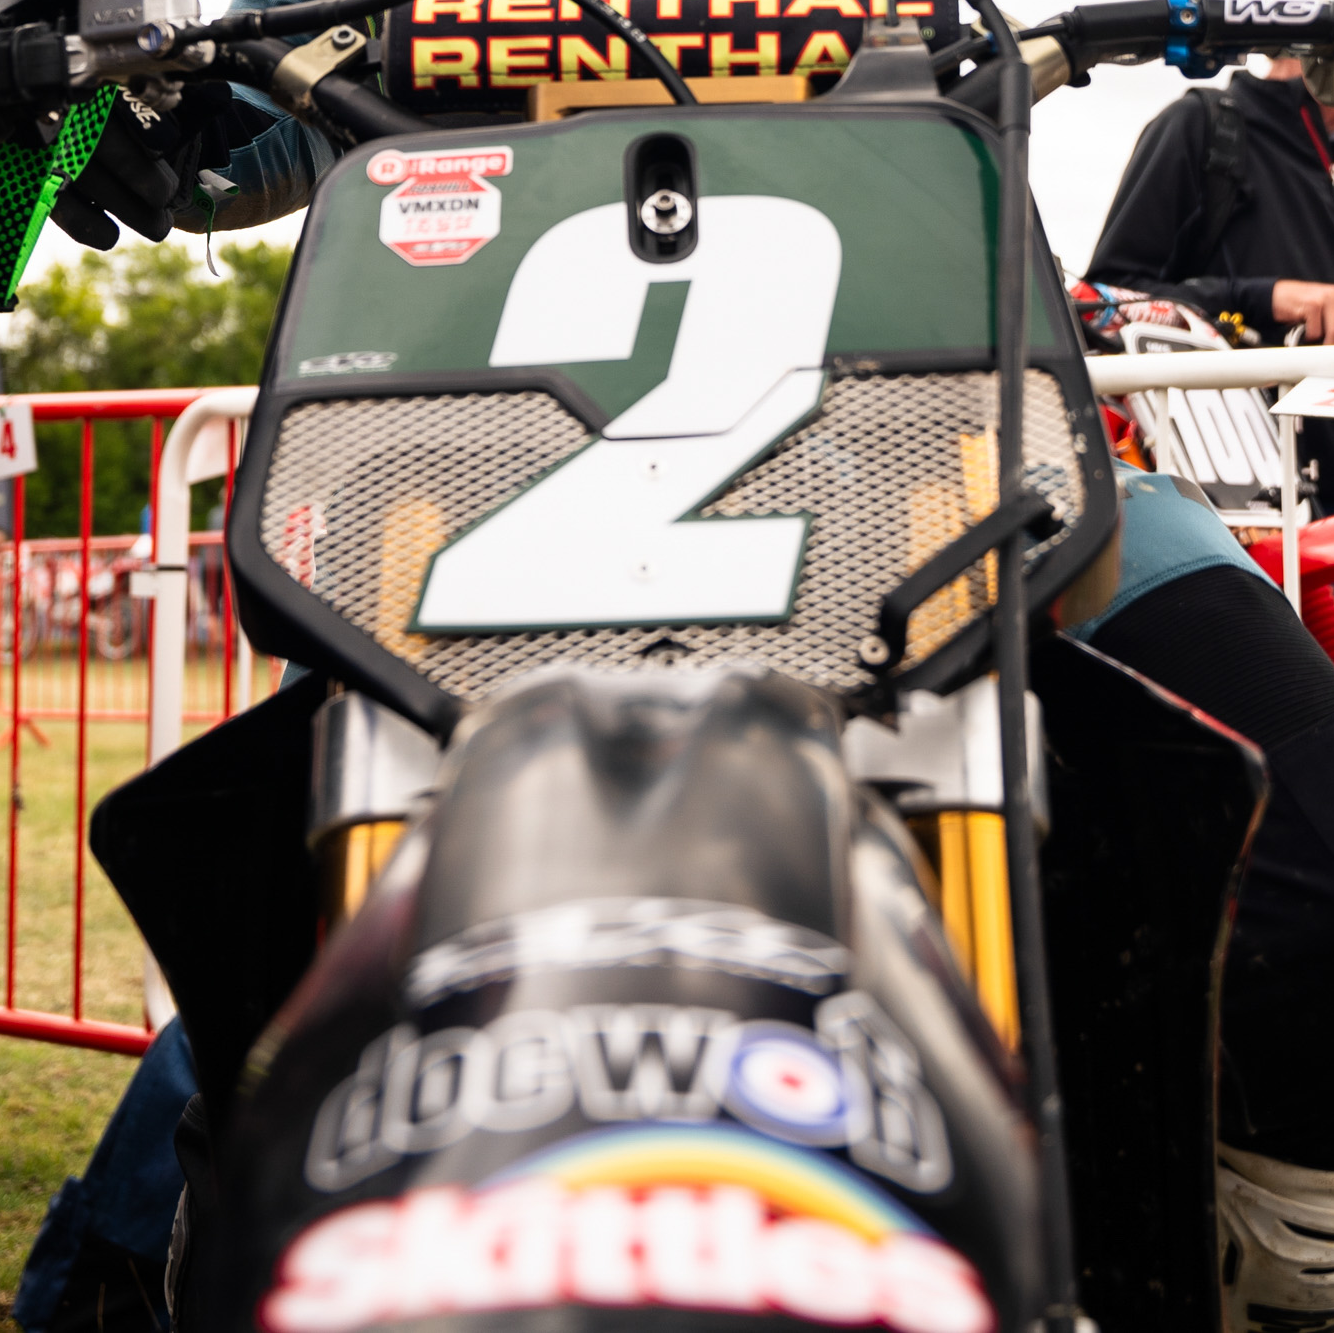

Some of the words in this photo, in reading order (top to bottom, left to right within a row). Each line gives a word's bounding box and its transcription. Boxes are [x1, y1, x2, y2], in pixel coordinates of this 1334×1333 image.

[411, 29, 853, 90] RENTHA
[399, 198, 479, 214] VMXDN
[411, 195, 842, 631] 2
[0, 421, 16, 459] 4
